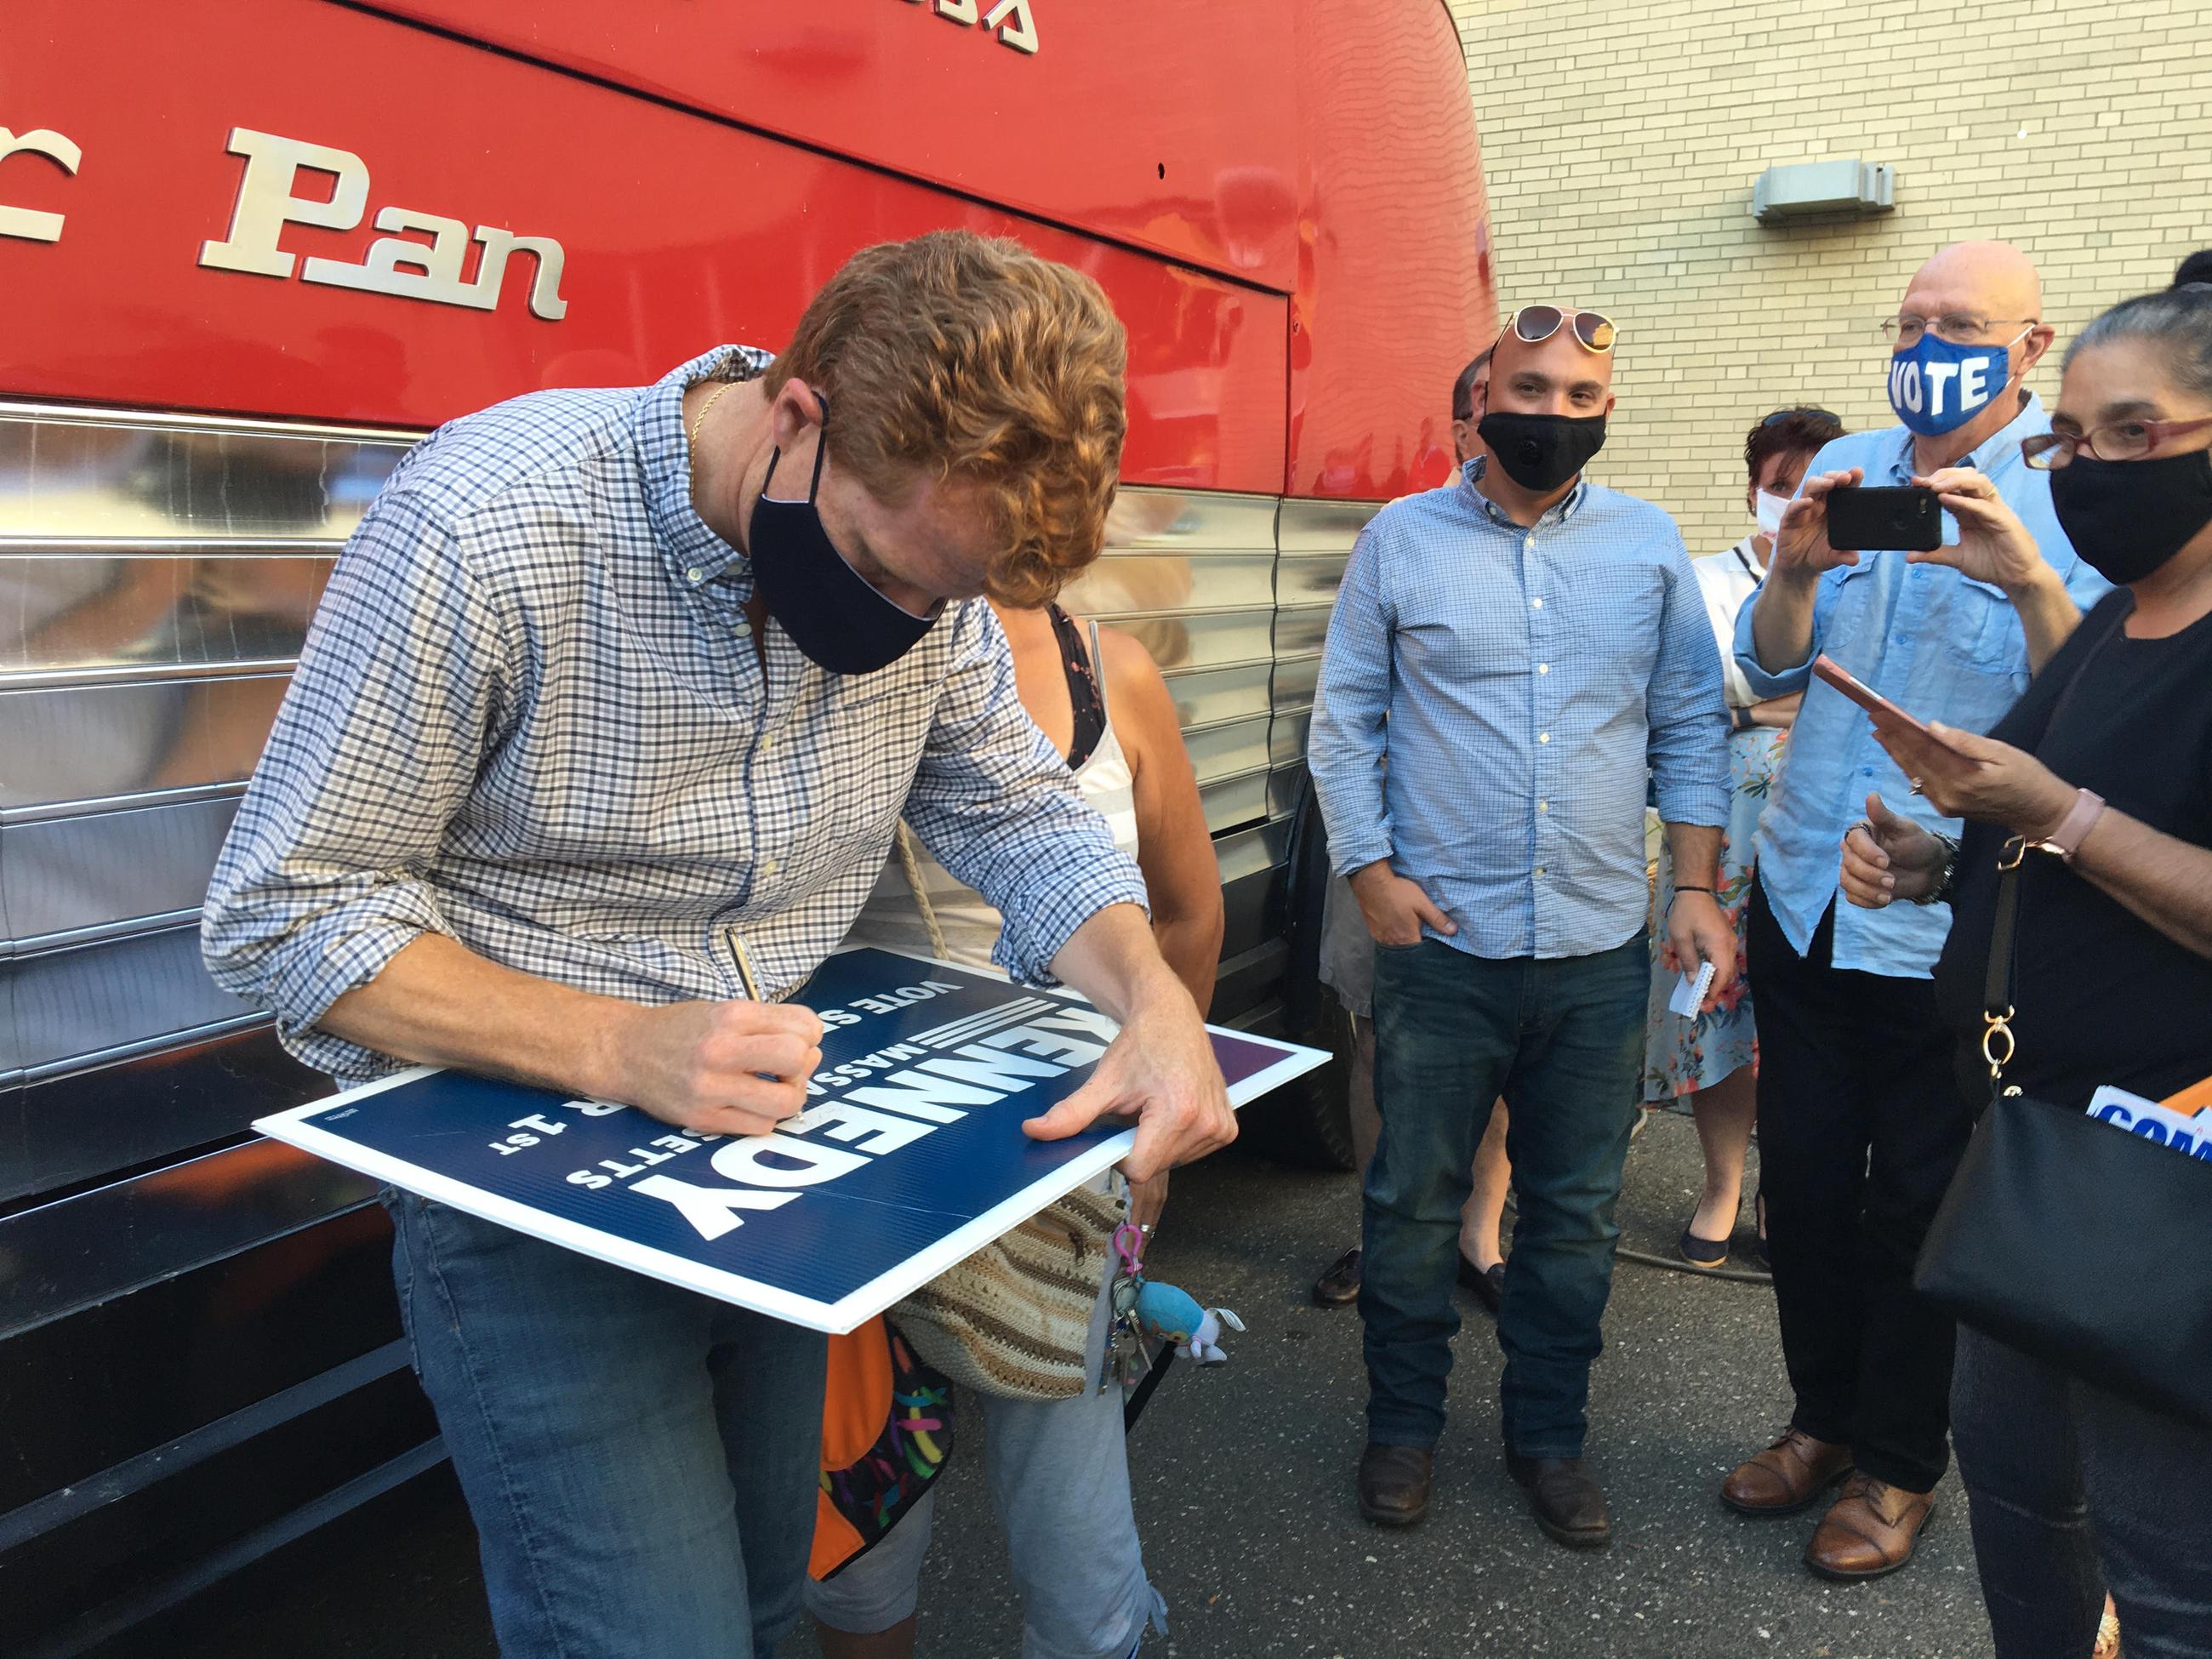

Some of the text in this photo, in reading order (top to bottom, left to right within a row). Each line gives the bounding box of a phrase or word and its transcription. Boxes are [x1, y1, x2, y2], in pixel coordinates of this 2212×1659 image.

[197, 126, 568, 321] Pan
[1890, 356, 1990, 416] VOTE
[487, 980, 965, 1156] VOTE 1ST
[627, 1006, 1122, 1242] KENNEDY
